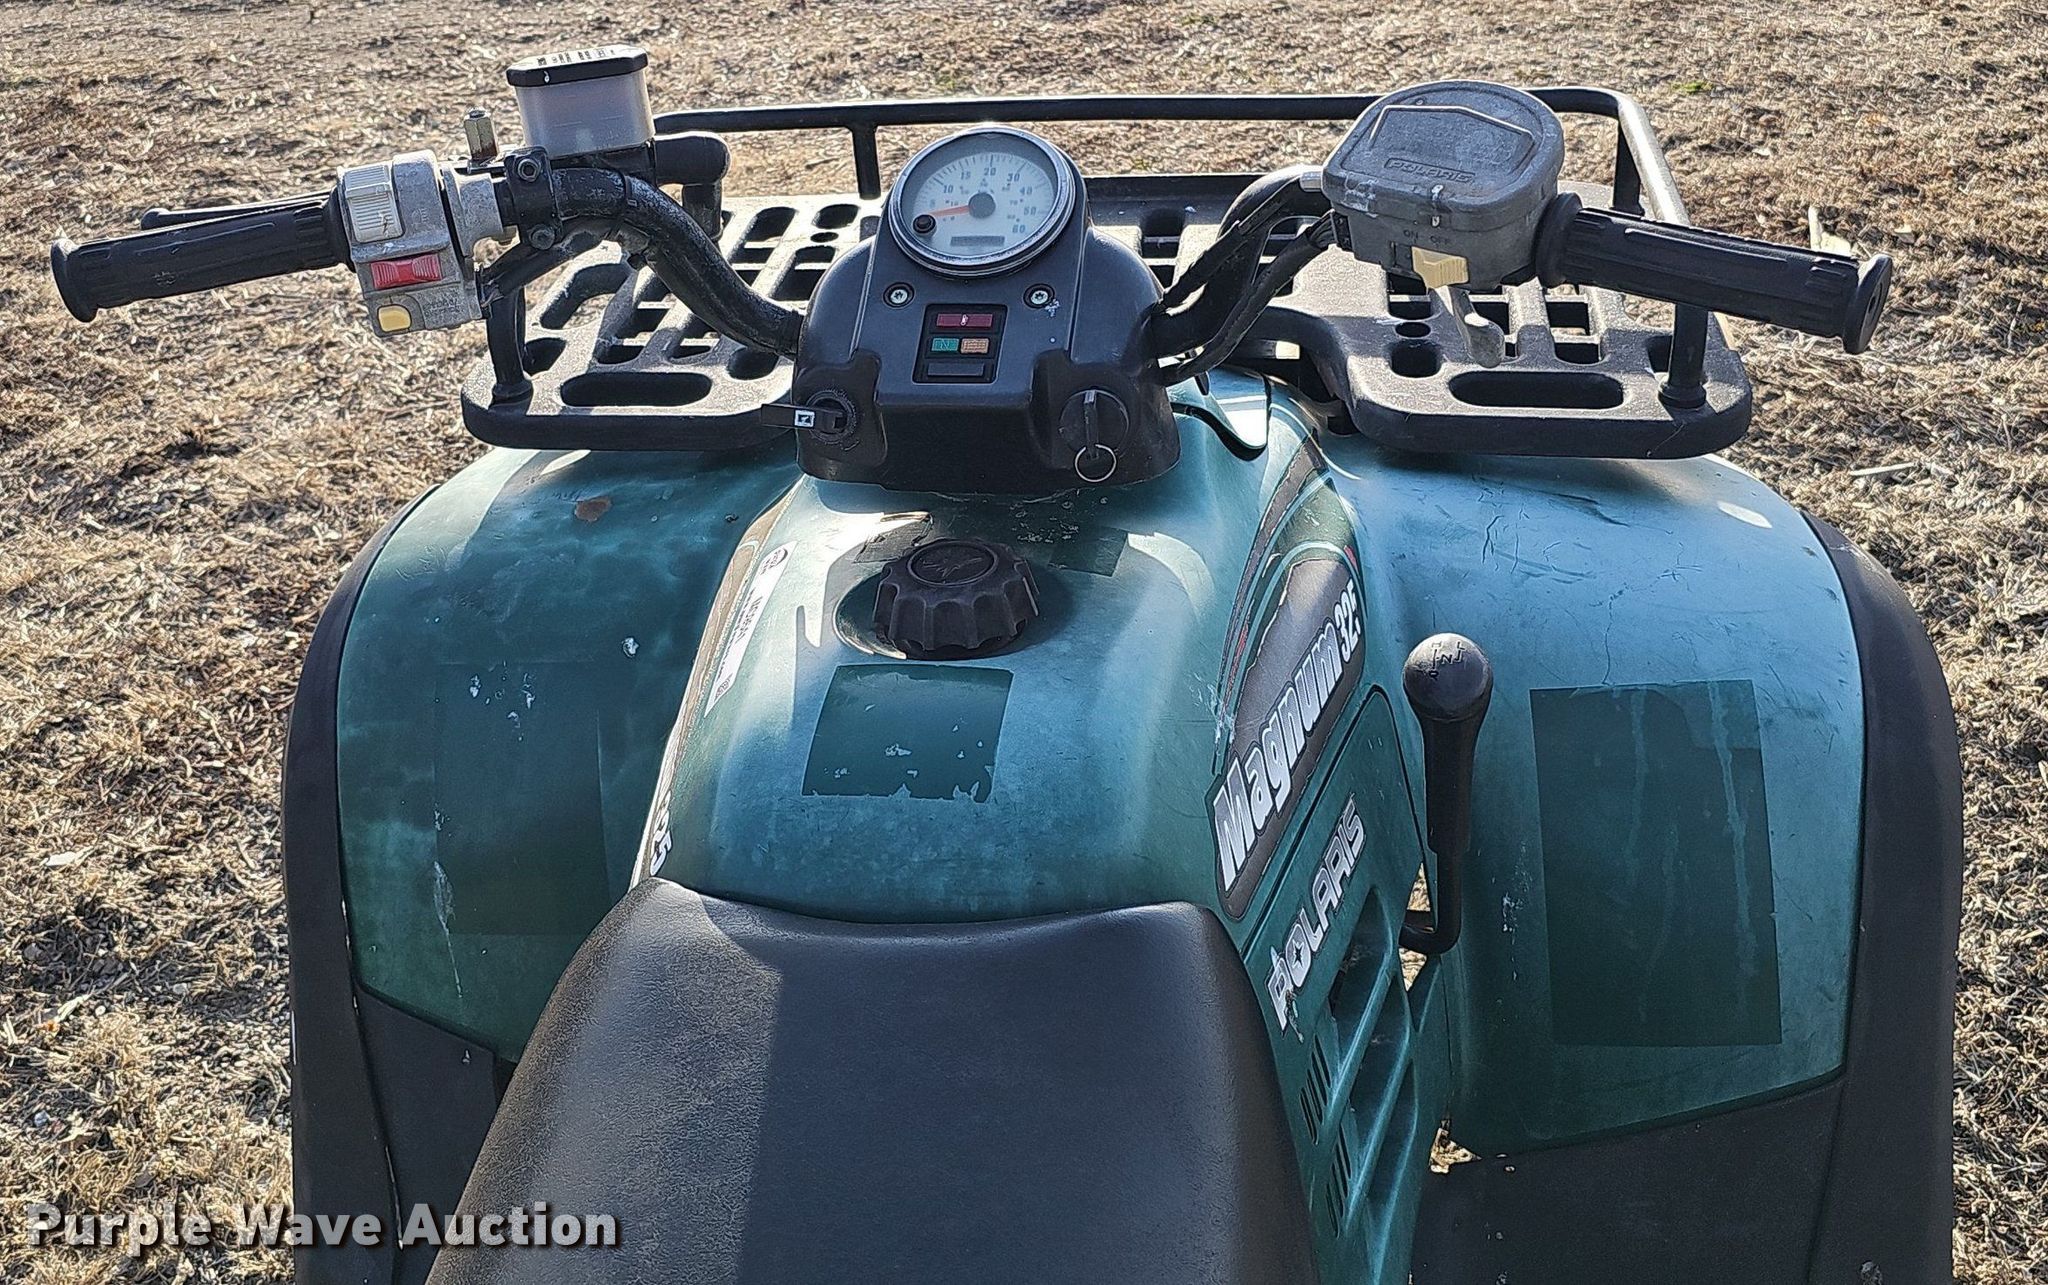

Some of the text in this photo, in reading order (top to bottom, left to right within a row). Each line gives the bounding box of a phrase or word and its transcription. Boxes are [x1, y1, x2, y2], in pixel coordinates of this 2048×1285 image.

[961, 171, 971, 180] 15
[984, 167, 996, 176] 20
[1387, 159, 1474, 184] POLARIS
[1006, 173, 1020, 182] 30
[943, 185, 954, 194] 10
[1020, 186, 1032, 195] 40
[1023, 206, 1037, 216] 50
[1012, 224, 1026, 234] 60
[1403, 229, 1419, 240] ON
[1213, 620, 1343, 892] Magnum
[1267, 799, 1365, 1032] POLARIS
